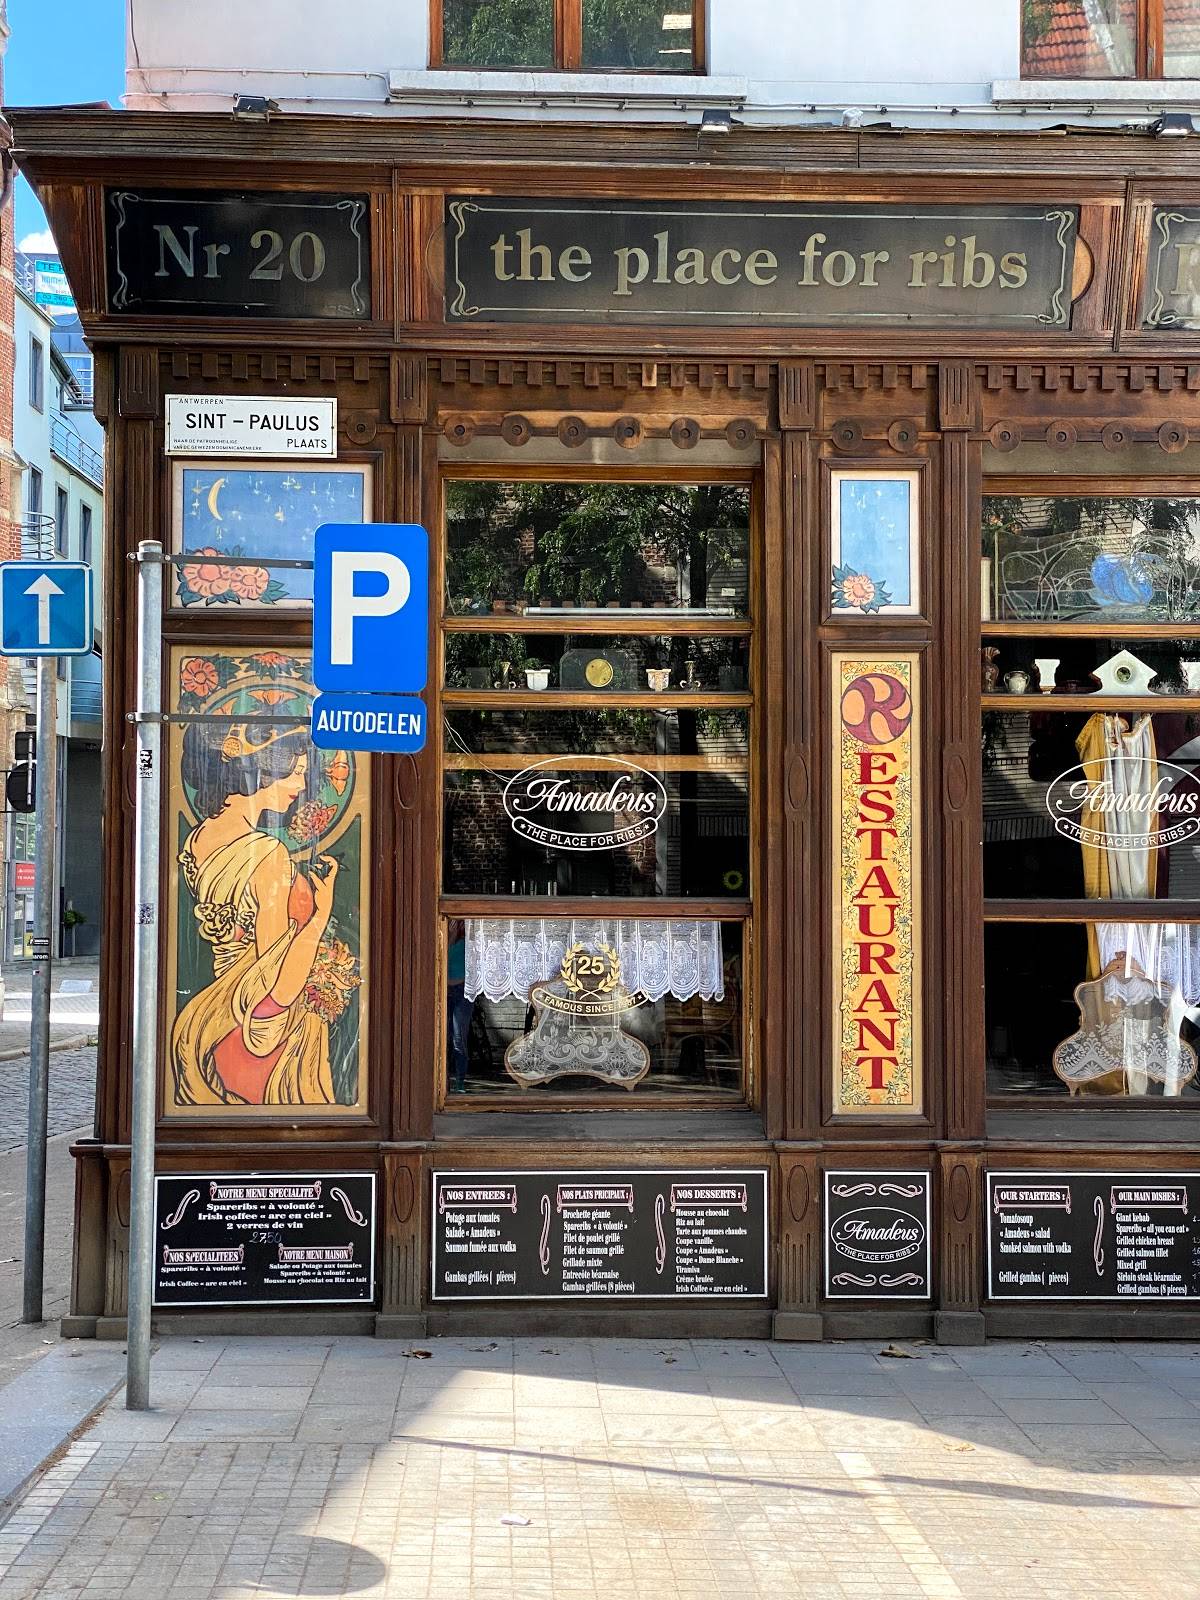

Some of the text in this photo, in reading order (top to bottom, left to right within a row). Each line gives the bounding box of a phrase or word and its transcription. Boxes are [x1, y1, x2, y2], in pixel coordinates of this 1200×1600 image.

[153, 224, 325, 283] Nr 20
[491, 228, 1028, 296] the place for ribs
[186, 413, 319, 431] SINT PAULUS
[287, 439, 327, 448] PLAATS
[331, 552, 410, 665] P
[317, 710, 422, 736] AUTODELEN
[513, 776, 657, 813] Amadeus
[1056, 777, 1198, 812] Amadeus
[526, 824, 643, 847] THE PLACE FOR RIBS
[1070, 825, 1185, 846] THE PLACE FOR RIBS
[840, 672, 913, 1089] RESTAURANT
[578, 956, 604, 975] 25
[544, 995, 583, 1013] FAMOUS
[586, 1004, 613, 1013] SINCE
[218, 1188, 314, 1198] NOTRE MENU SPECIALITE
[447, 1191, 505, 1200] NOS ENTREES
[562, 1191, 574, 1199] NOS
[575, 1190, 593, 1199] PLATS
[677, 1190, 736, 1198] NOS DESSERTS
[1000, 1191, 1060, 1200] OUR STARTERS
[1119, 1192, 1176, 1201] OUR MAIN DISHES
[206, 1203, 257, 1212] Spareribs
[278, 1202, 315, 1210] volonté
[836, 1219, 918, 1240] Amadeus
[169, 1252, 184, 1262] NOS
[284, 1250, 348, 1259] NOTRE MENU MAISON
[843, 1247, 856, 1257] THE
